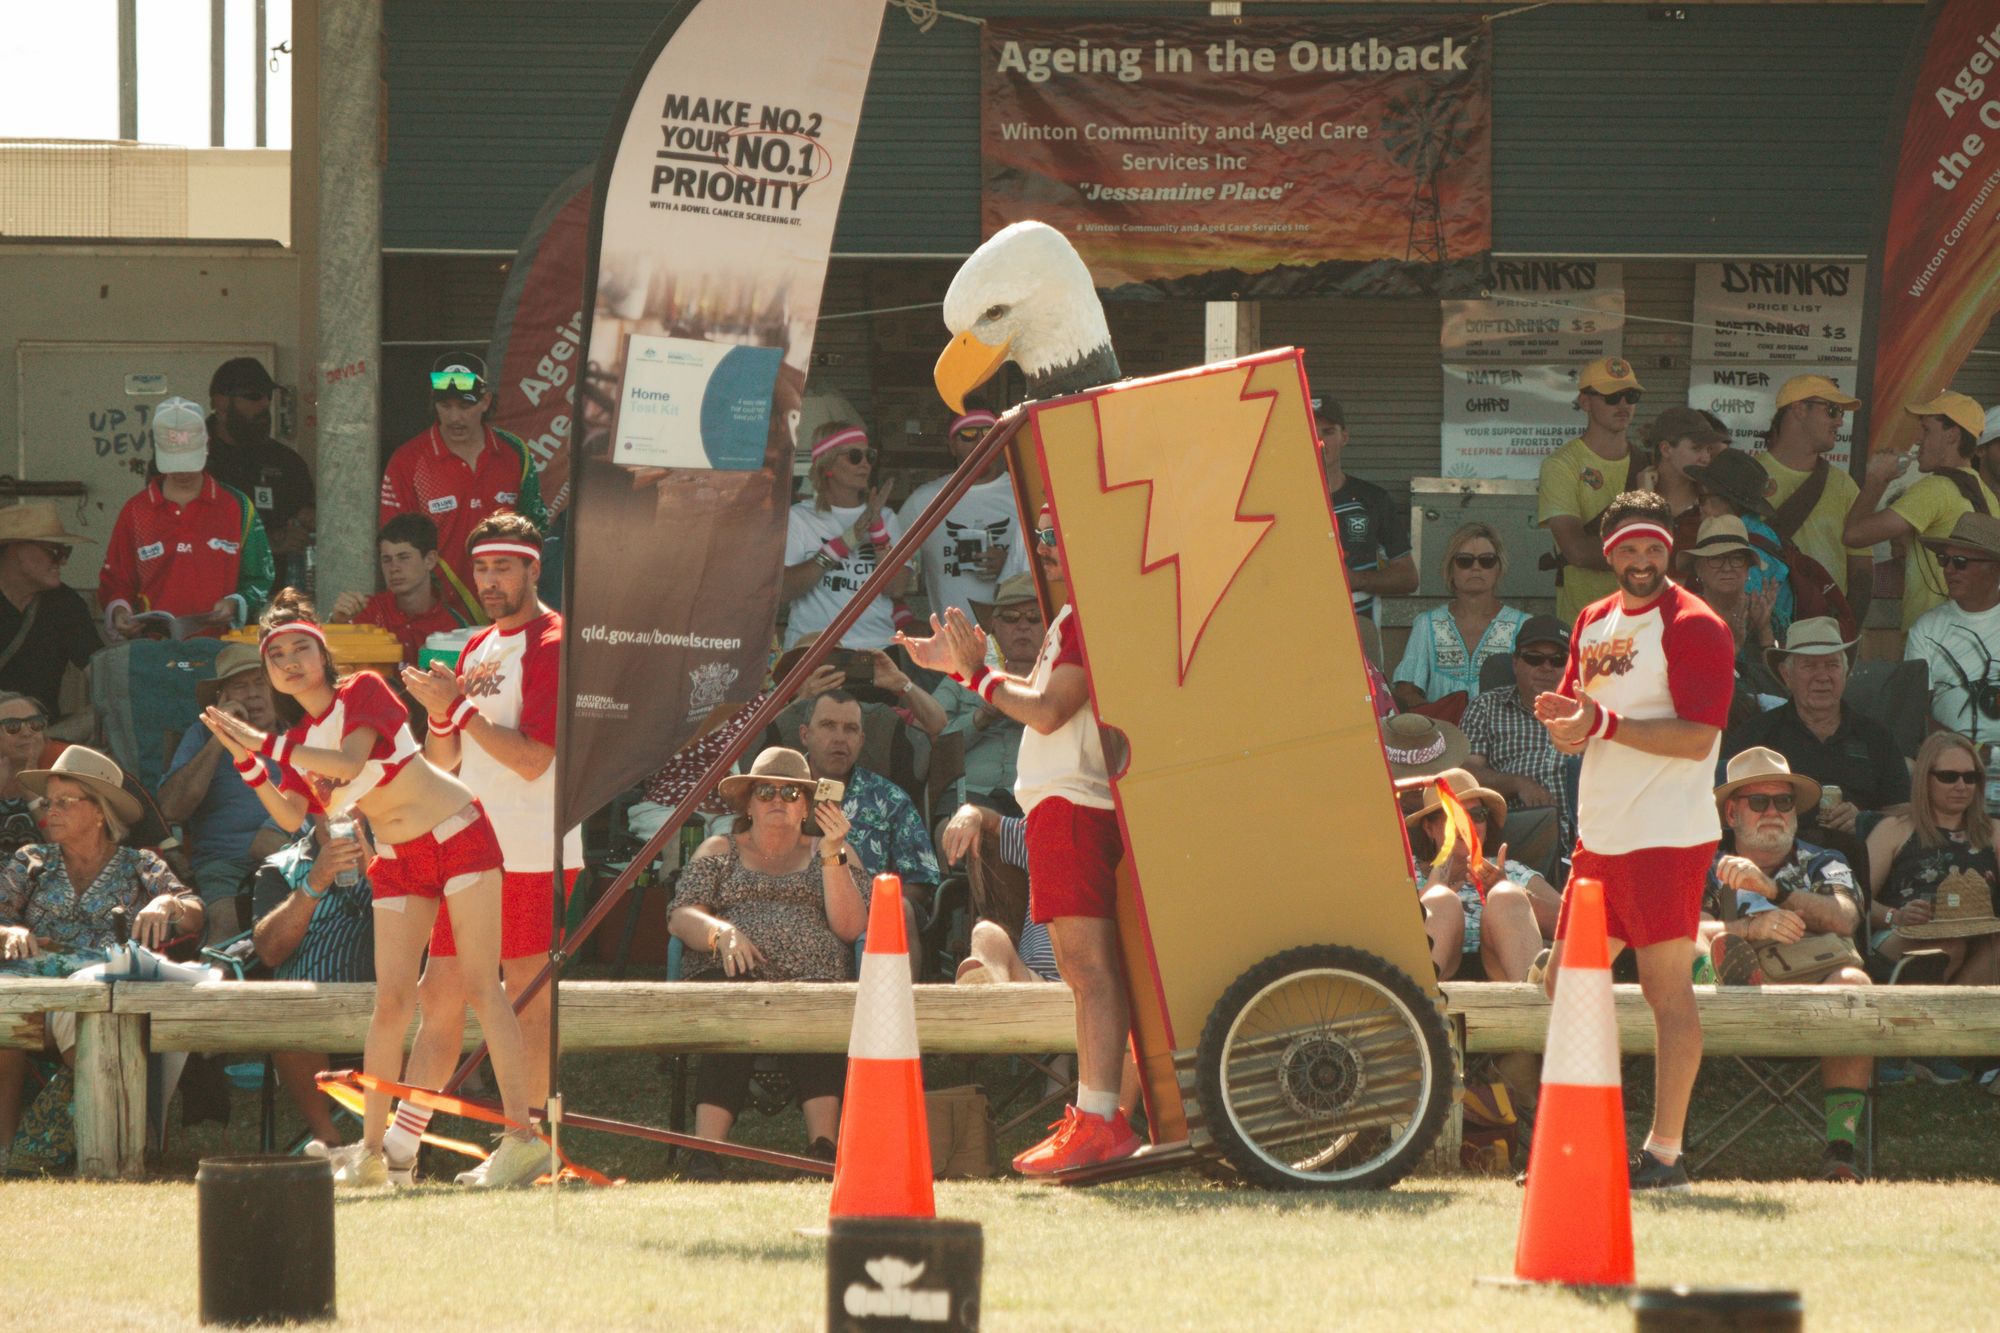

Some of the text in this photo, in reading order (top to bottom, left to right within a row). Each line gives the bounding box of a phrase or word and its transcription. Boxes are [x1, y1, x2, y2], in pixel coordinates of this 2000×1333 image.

[997, 37, 1469, 82] Ageing in the Outback
[662, 94, 823, 138] MAKE NO.2
[1001, 122, 1369, 145] Winton Community and Aged Care
[661, 125, 815, 177] YOUR NO.1
[1122, 153, 1247, 171] Services Inc
[1932, 133, 1985, 190] the
[651, 165, 811, 211] PRIORITY
[1080, 182, 1294, 201] "Jessamine Place"
[649, 201, 672, 210] WITH
[681, 204, 711, 215] BOWEL
[712, 207, 744, 219] CANCER
[746, 212, 789, 225] SCREENING
[790, 217, 802, 226] KIT.
[1084, 223, 1120, 232] Winton
[1122, 223, 1179, 234] Community
[1181, 223, 1199, 232] and
[1201, 223, 1227, 234] Aged
[1229, 223, 1250, 232] Care
[1252, 223, 1292, 232] Services
[1294, 223, 1310, 232] Inc
[1908, 247, 1948, 297] Winton
[1747, 303, 1822, 312] PRICE LIST
[1572, 319, 1597, 332] $3
[1822, 324, 1847, 339] $3
[1466, 369, 1524, 385] WATER
[1713, 370, 1771, 387] WATER
[631, 388, 671, 401] Home
[631, 402, 681, 416] Test Kit
[1466, 398, 1510, 412] CHIPS
[1711, 399, 1755, 414] CHIPS
[89, 407, 127, 432] UP
[1464, 427, 1489, 436] YOUR
[1491, 427, 1533, 436] SUPPORT
[1535, 427, 1563, 436] HELPS
[1565, 427, 1577, 436] US
[92, 429, 154, 457] DEVI
[1511, 437, 1563, 446] EFFORTS TO
[1506, 447, 1552, 456] FAMILIES
[259, 491, 268, 503] 6
[853, 563, 877, 575] CIT
[581, 625, 741, 649] qld.gov.au/bowelscreen
[576, 693, 614, 704] NATIONAL
